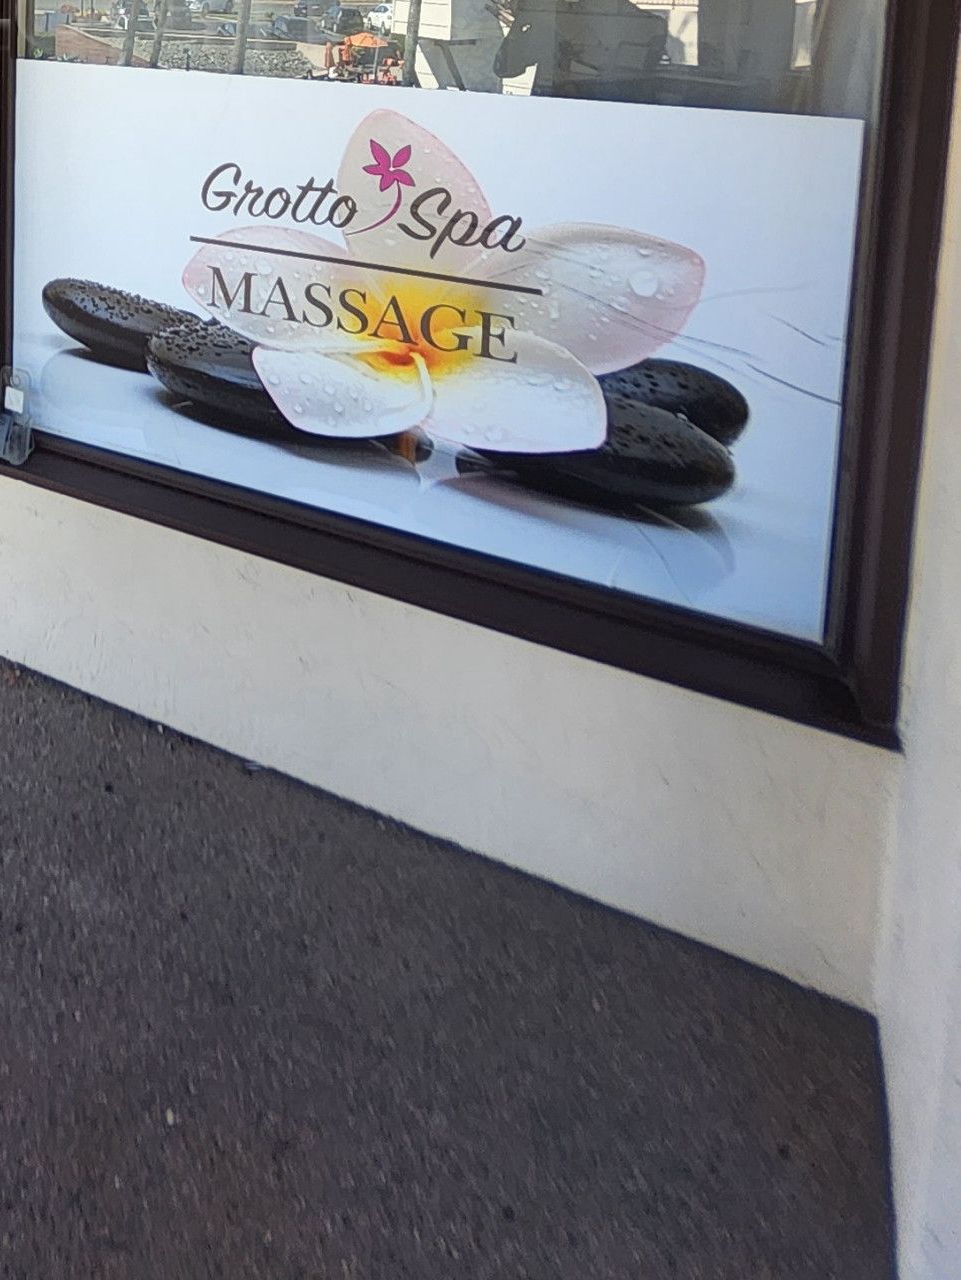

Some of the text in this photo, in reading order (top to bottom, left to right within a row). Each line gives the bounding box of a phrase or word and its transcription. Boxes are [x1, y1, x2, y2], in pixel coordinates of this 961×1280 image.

[201, 162, 526, 259] Grotto Spa
[206, 265, 518, 364] MASSAGE
